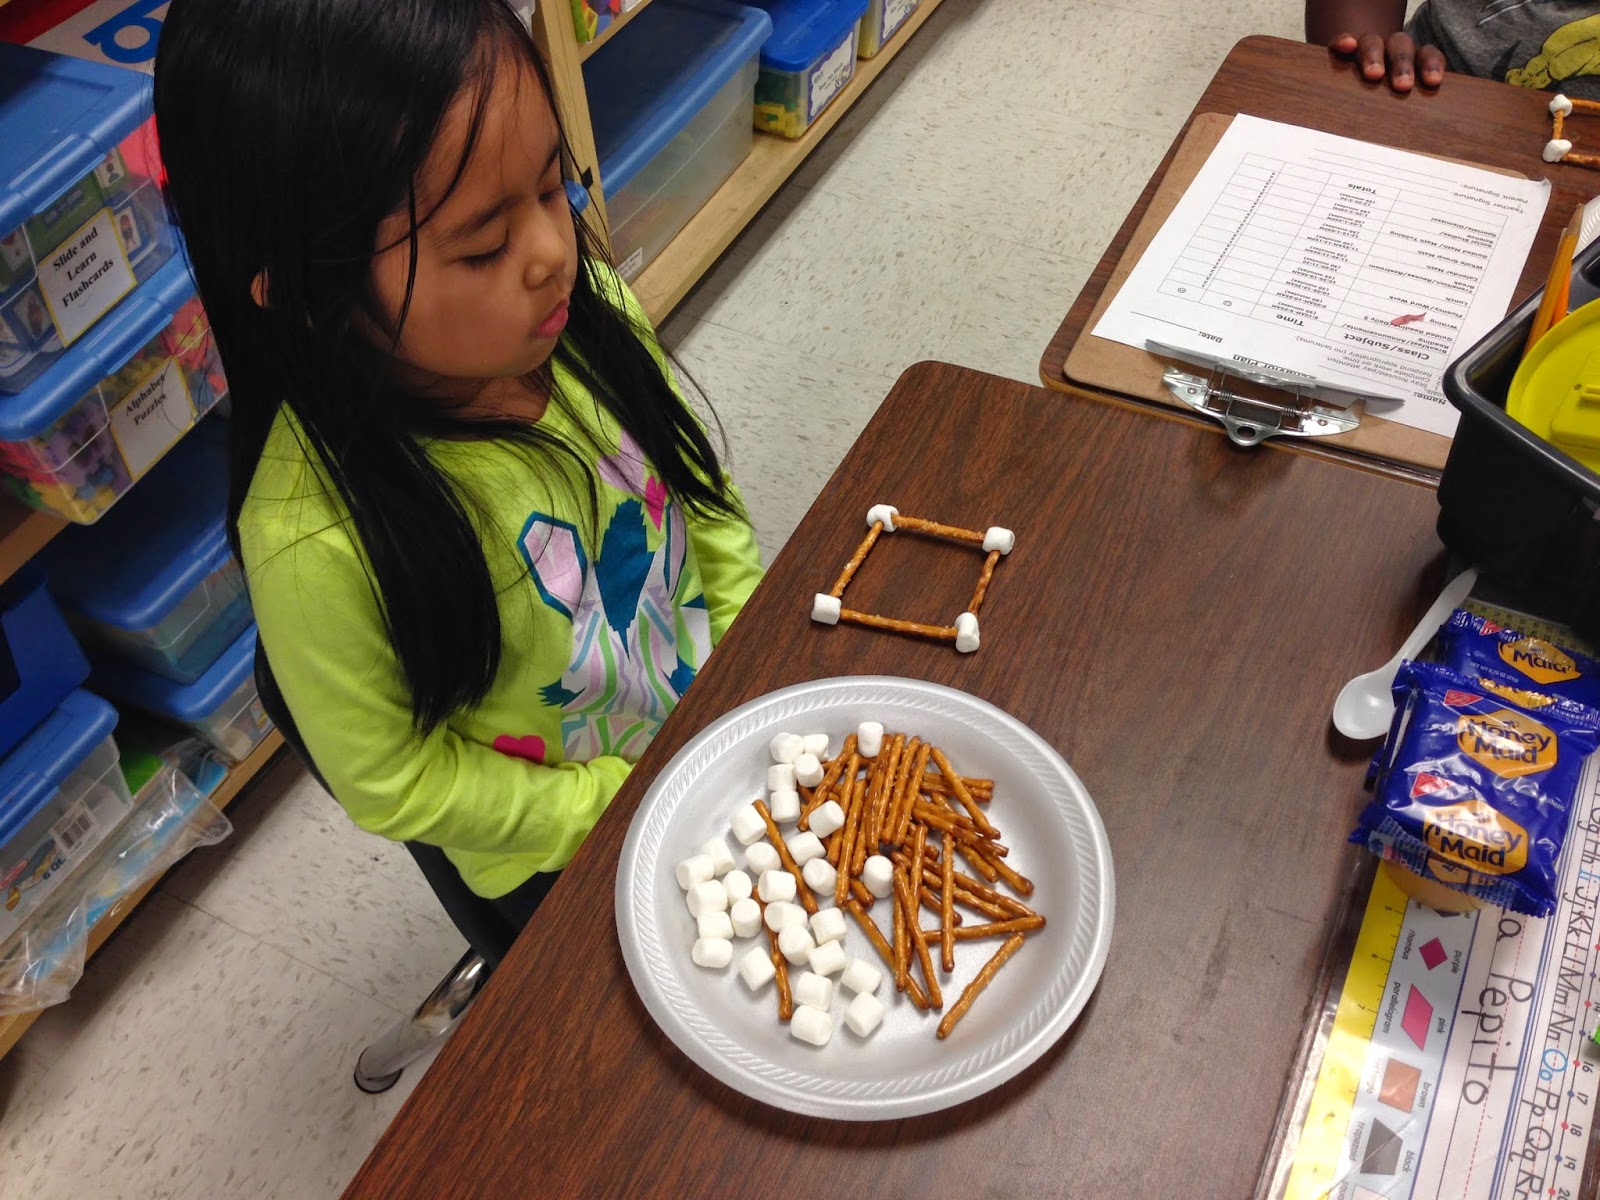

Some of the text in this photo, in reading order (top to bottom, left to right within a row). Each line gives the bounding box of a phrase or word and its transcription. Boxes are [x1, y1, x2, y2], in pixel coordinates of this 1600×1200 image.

[1348, 183, 1376, 194] Totals
[53, 227, 99, 272] Slide and
[1462, 249, 1487, 259] Guided
[67, 252, 97, 282] Learn
[1436, 255, 1458, 263] Group
[1460, 261, 1482, 269] Whole
[62, 260, 113, 307] Flashcards
[1368, 264, 1471, 293] Transition/Recess/Restroom
[1446, 270, 1478, 281] Calendar
[1453, 281, 1474, 289] Break
[1389, 295, 1462, 318] Fluency/Word Work
[1445, 297, 1467, 306] Lunch
[1276, 314, 1303, 326] Time
[1429, 318, 1457, 329] Writing
[1198, 331, 1222, 343] Date:
[1342, 323, 1447, 354] Breakfast/Announcements/
[1418, 337, 1449, 349] Reading
[1425, 331, 1452, 341] Guided
[1343, 333, 1429, 359] Class/Subject
[1348, 351, 1397, 367] appropriately
[1373, 363, 1391, 371] work
[1362, 365, 1408, 382] focused/pay
[1393, 369, 1430, 382] Complete
[1399, 365, 1432, 377] Respond
[1409, 379, 1427, 388] Stay
[126, 373, 165, 416] Alphabet
[1413, 391, 1446, 404] Name:
[133, 393, 165, 425] Puzzles
[1469, 719, 1552, 752] Honey
[1475, 737, 1537, 765] Maid
[1435, 814, 1523, 853] Honey
[1440, 837, 1506, 867] Maid
[1402, 929, 1415, 960] rhombus
[1451, 949, 1462, 974] purple
[1382, 981, 1401, 1034] parallelogram
[1436, 1017, 1446, 1034] pink
[1461, 972, 1535, 1105] Pepito
[1582, 1061, 1594, 1074] 16
[1418, 1081, 1432, 1108] brown
[1576, 1092, 1589, 1105] 17
[1570, 1123, 1583, 1137] 18
[1349, 1121, 1366, 1162] trapezoid
[1402, 1150, 1415, 1173] black
[1564, 1156, 1577, 1171] 19
